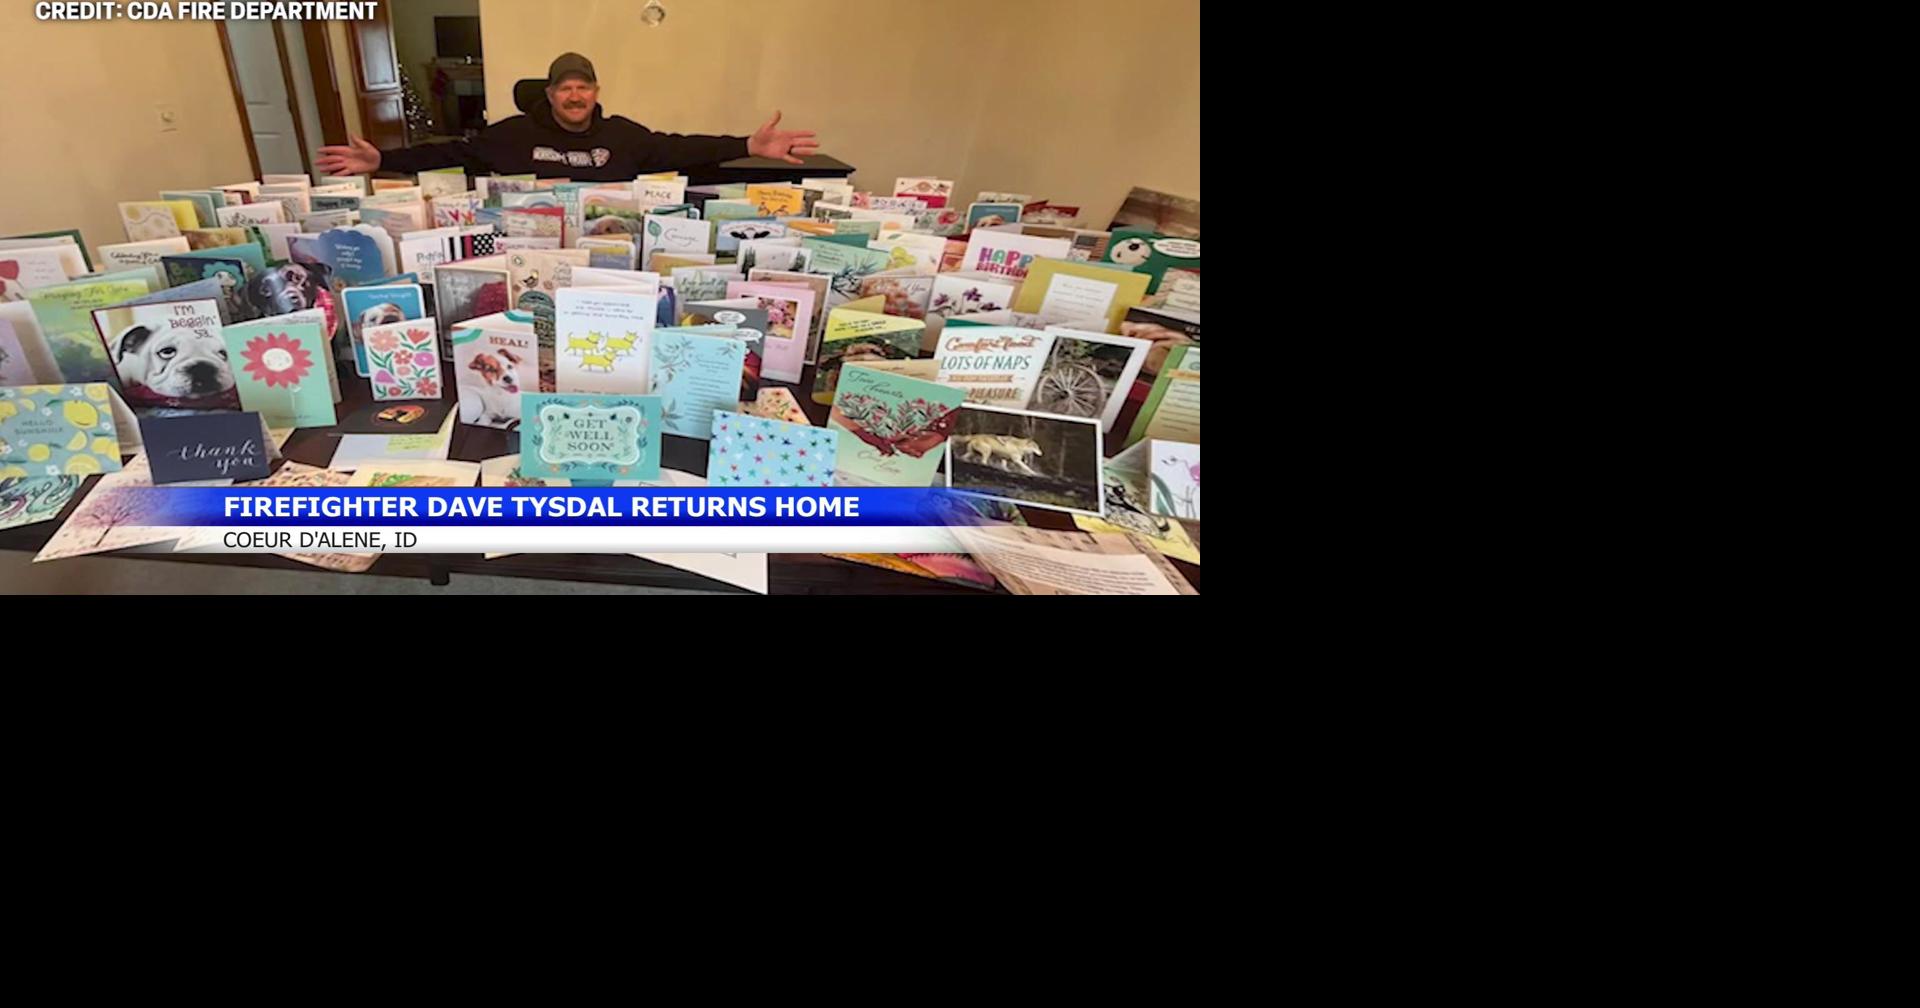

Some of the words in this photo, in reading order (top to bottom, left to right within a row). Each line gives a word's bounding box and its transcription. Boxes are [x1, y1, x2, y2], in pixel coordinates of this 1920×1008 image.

[644, 189, 673, 200] PEACE
[979, 246, 1033, 268] HAPP
[975, 261, 1030, 279] BIRTHD
[488, 335, 529, 349] HEAL!
[941, 355, 973, 370] LOTS
[973, 355, 991, 370] OF
[992, 355, 1032, 371] NAPS
[968, 387, 1020, 401] PLEASURE
[573, 419, 608, 429] GET
[569, 430, 614, 441] WELL
[172, 439, 258, 460] thank
[567, 441, 614, 452] SOON
[216, 457, 256, 475] you
